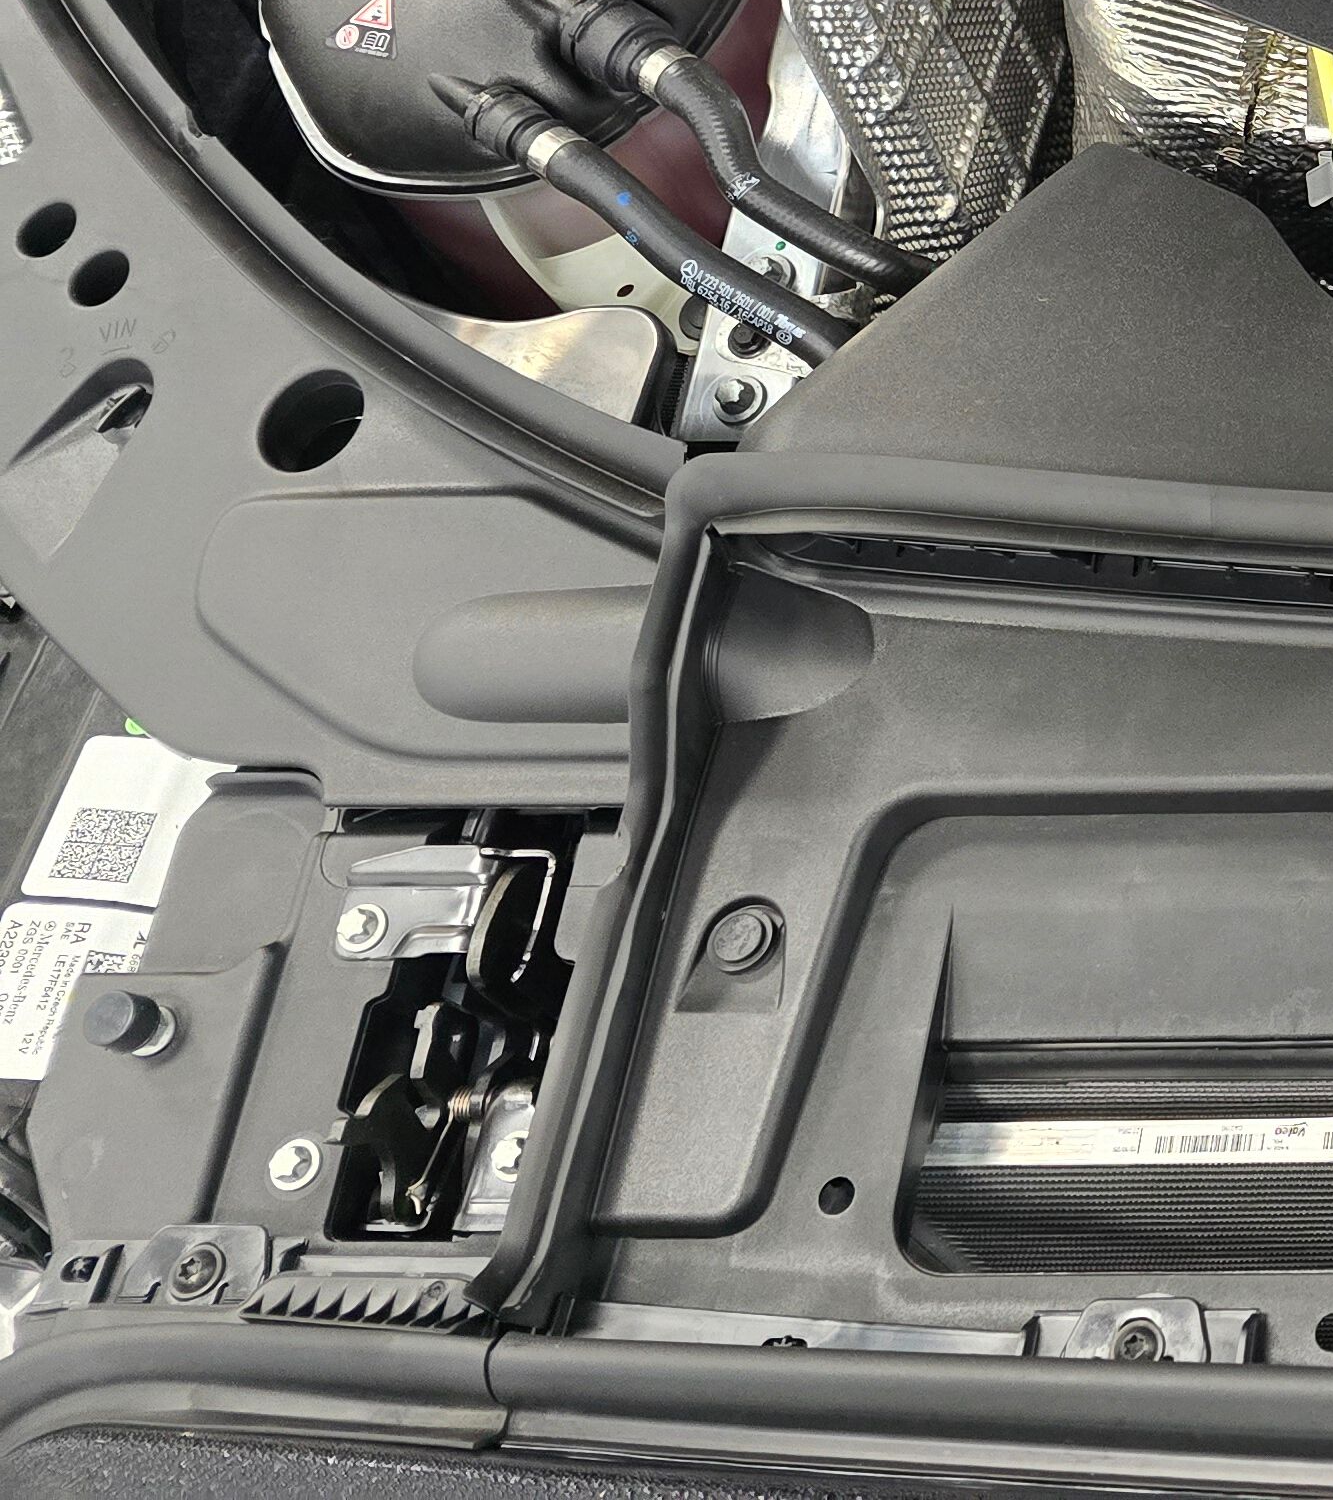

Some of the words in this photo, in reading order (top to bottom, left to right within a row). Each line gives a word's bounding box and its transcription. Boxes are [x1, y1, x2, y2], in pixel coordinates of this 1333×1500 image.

[694, 269, 705, 283] A
[702, 273, 720, 291] 223
[718, 282, 736, 300] 501
[98, 317, 138, 343] VIN
[22, 919, 42, 945] ZGS
[59, 921, 75, 941] SAE
[70, 922, 93, 945] RA
[3, 933, 54, 1026] Mercedes-Benz
[1274, 1122, 1309, 1140] Valeo
